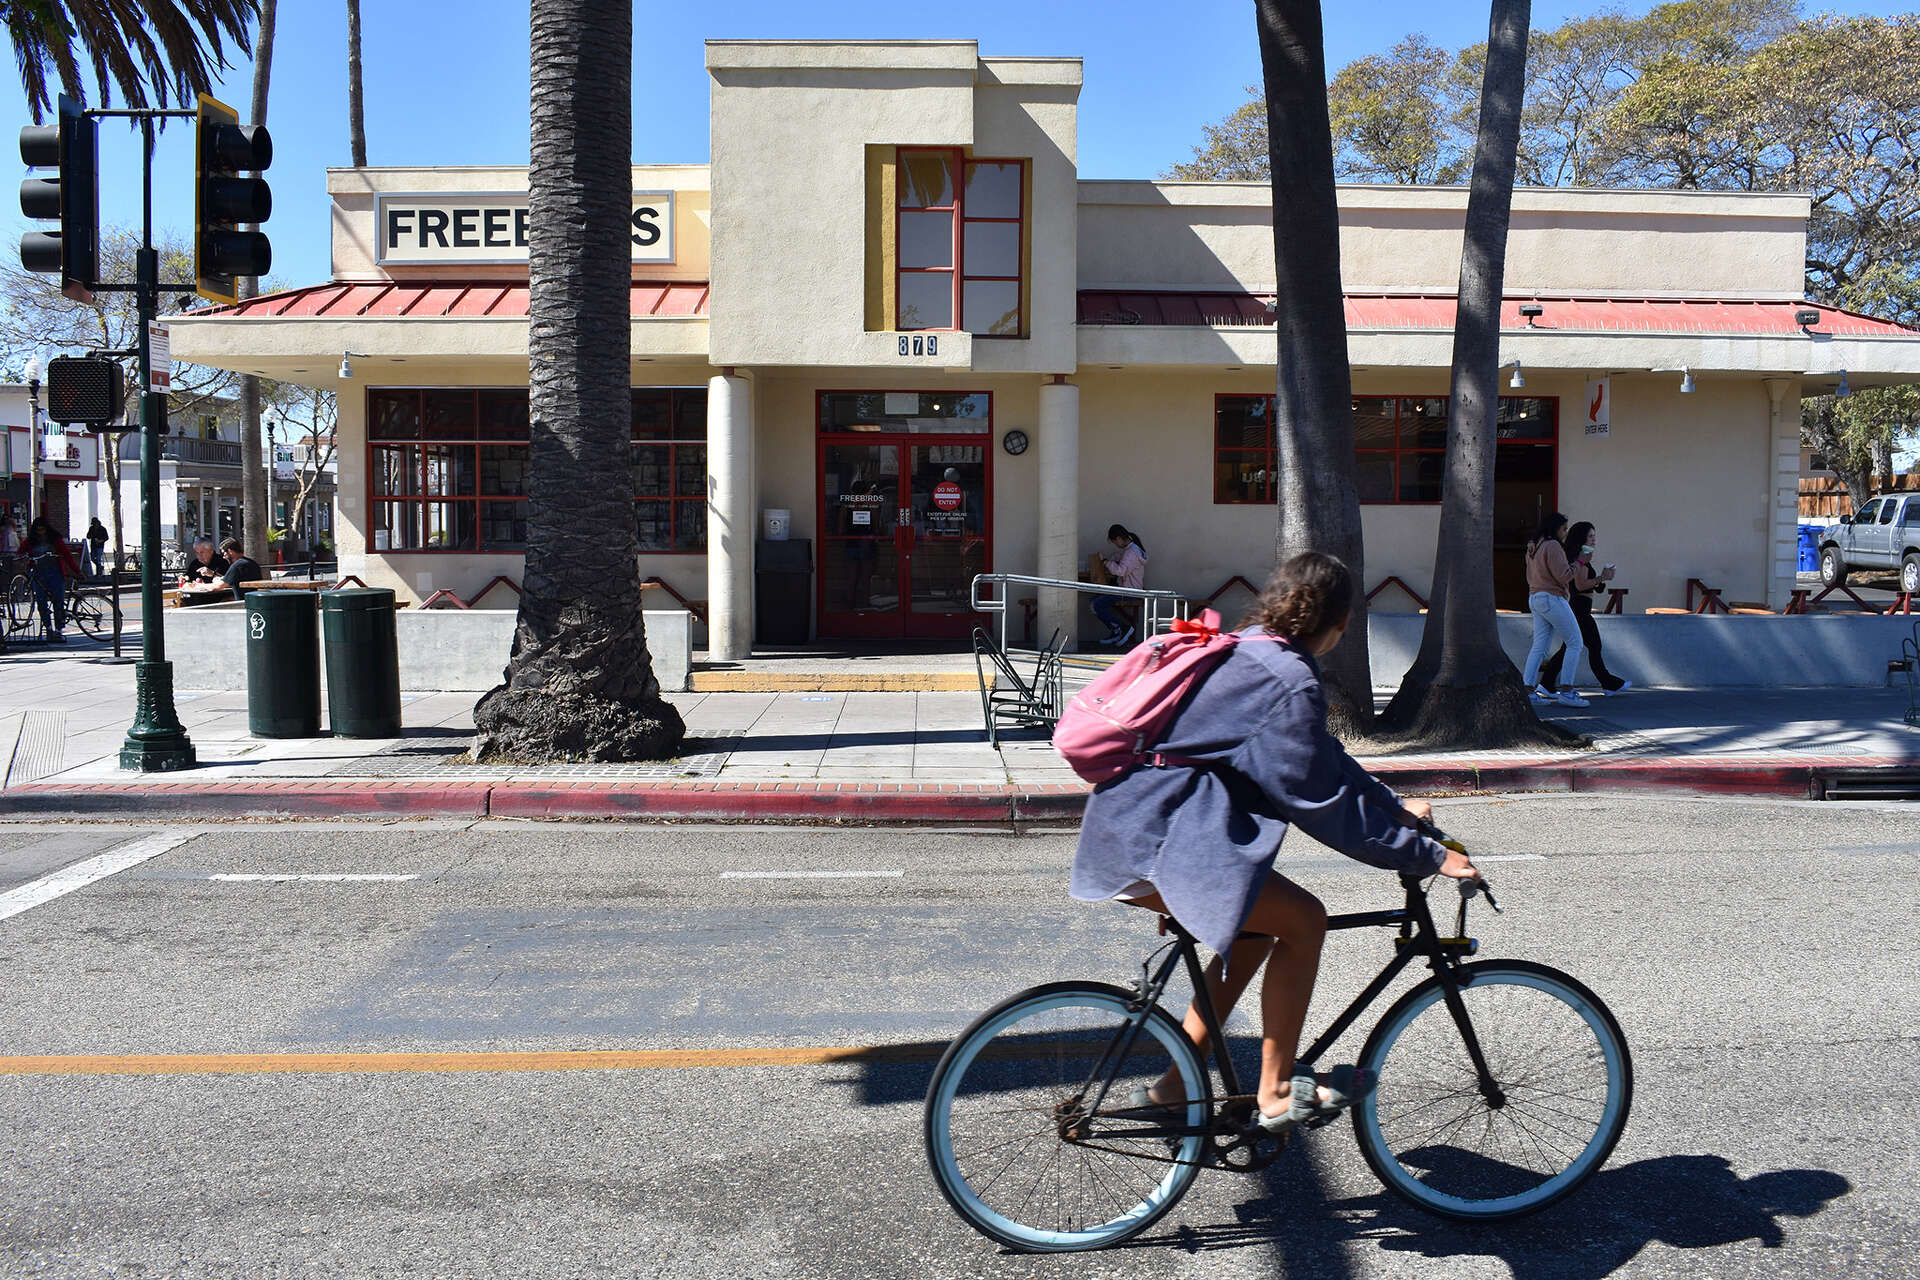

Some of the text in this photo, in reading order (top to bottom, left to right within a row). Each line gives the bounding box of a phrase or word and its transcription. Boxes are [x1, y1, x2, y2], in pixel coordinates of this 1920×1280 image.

[900, 336, 937, 355] 879
[43, 422, 65, 435] VIVA
[1584, 424, 1608, 435] ENTER HERE
[277, 452, 294, 462] GIVE
[840, 494, 884, 502] FREEBIRDS
